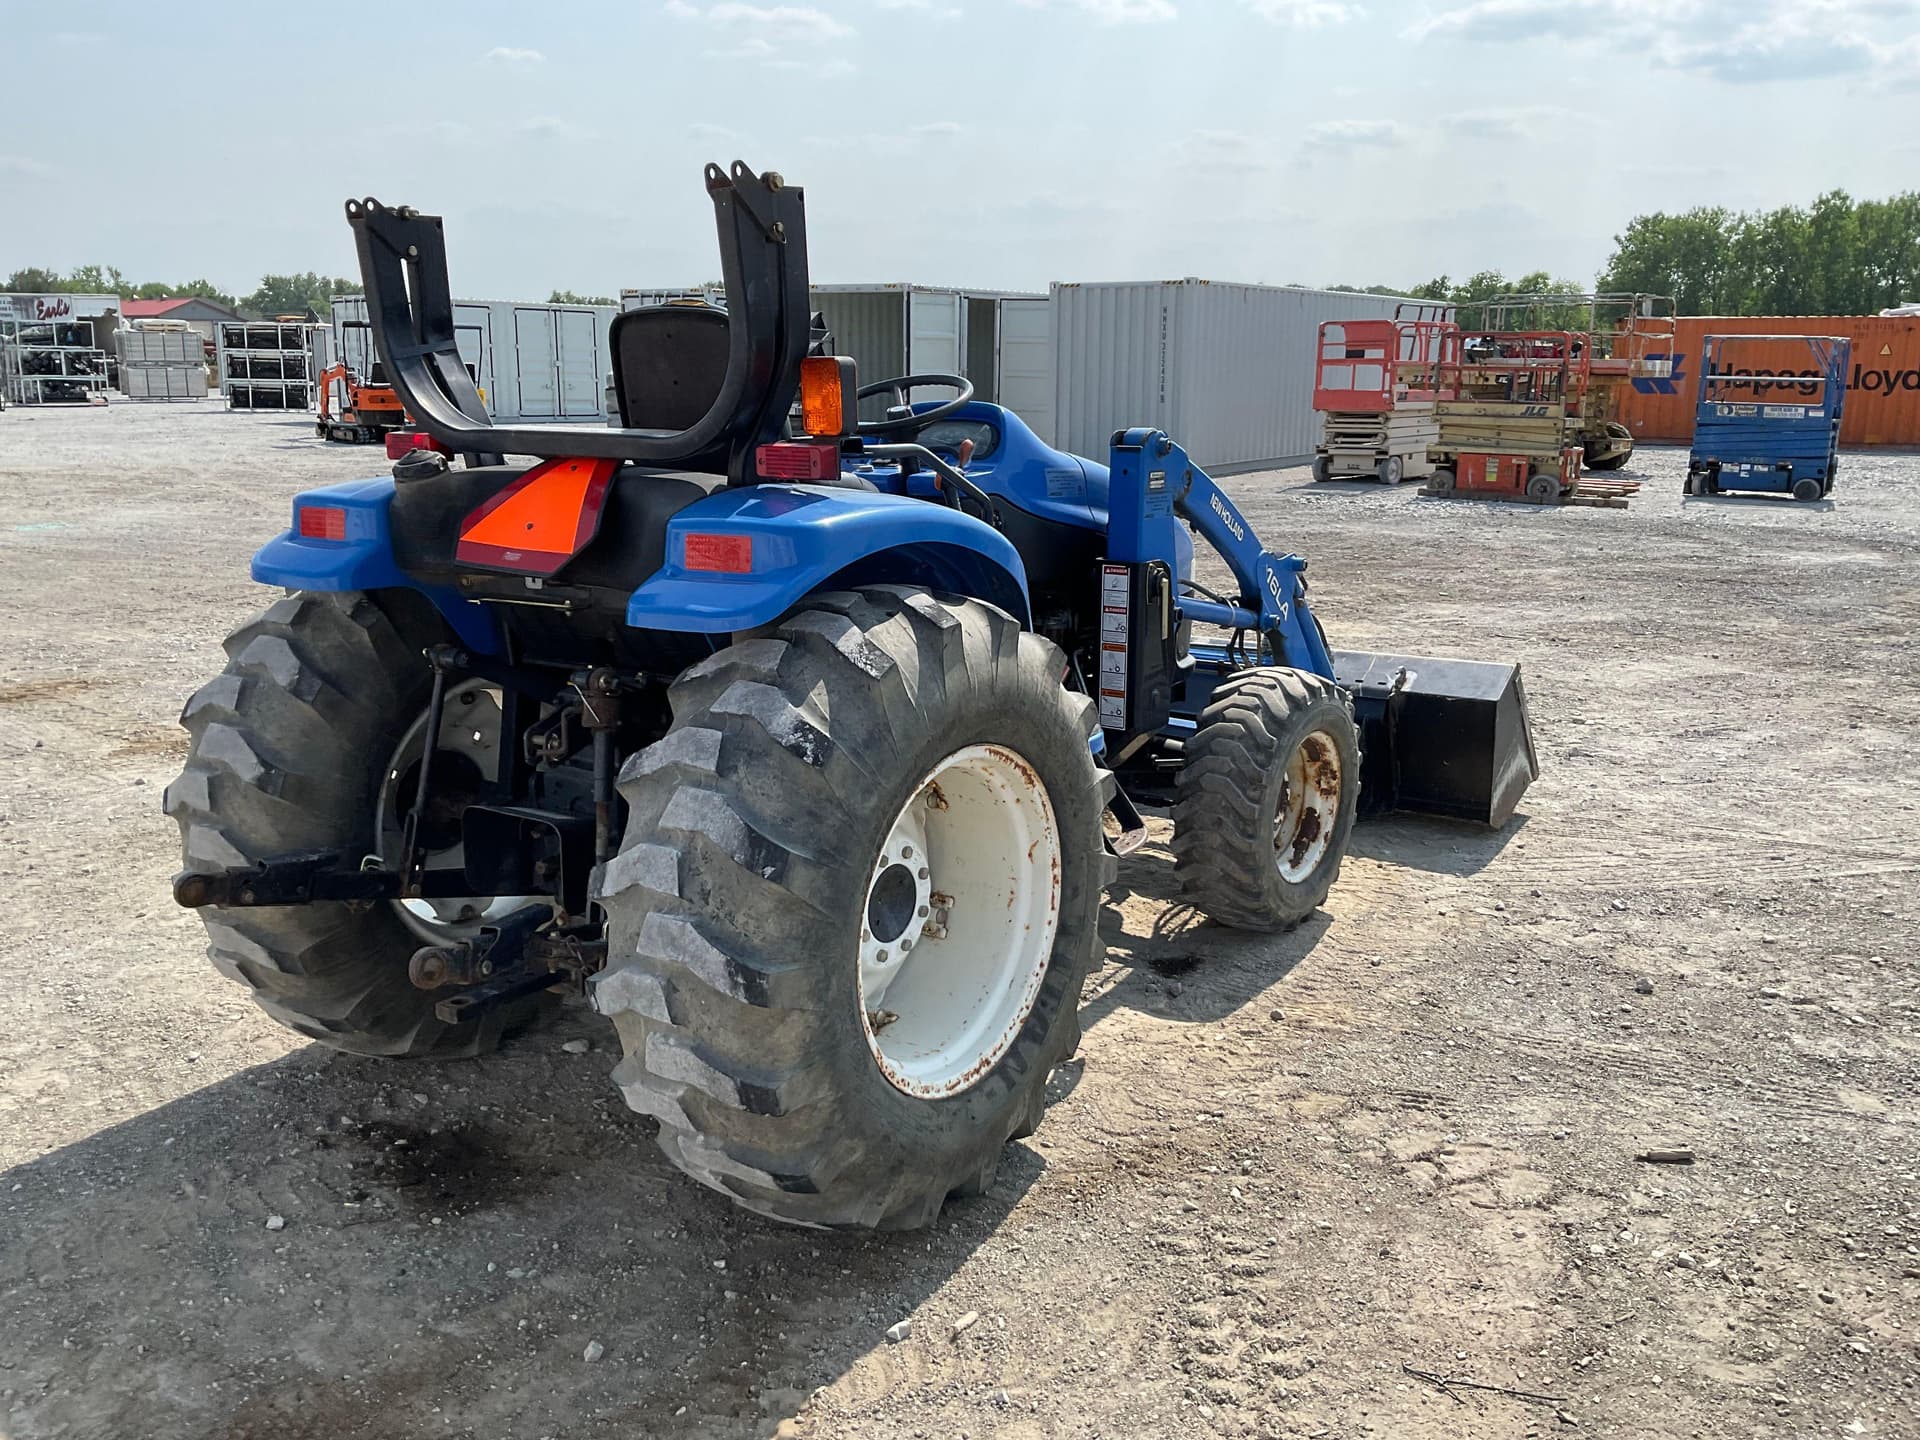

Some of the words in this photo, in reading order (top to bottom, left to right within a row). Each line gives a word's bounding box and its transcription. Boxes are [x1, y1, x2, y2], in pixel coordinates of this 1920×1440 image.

[1709, 363, 1820, 396] Hapag
[1520, 406, 1549, 417] JLG
[1220, 508, 1245, 542] HOLLAND
[1265, 564, 1290, 622] 16LA
